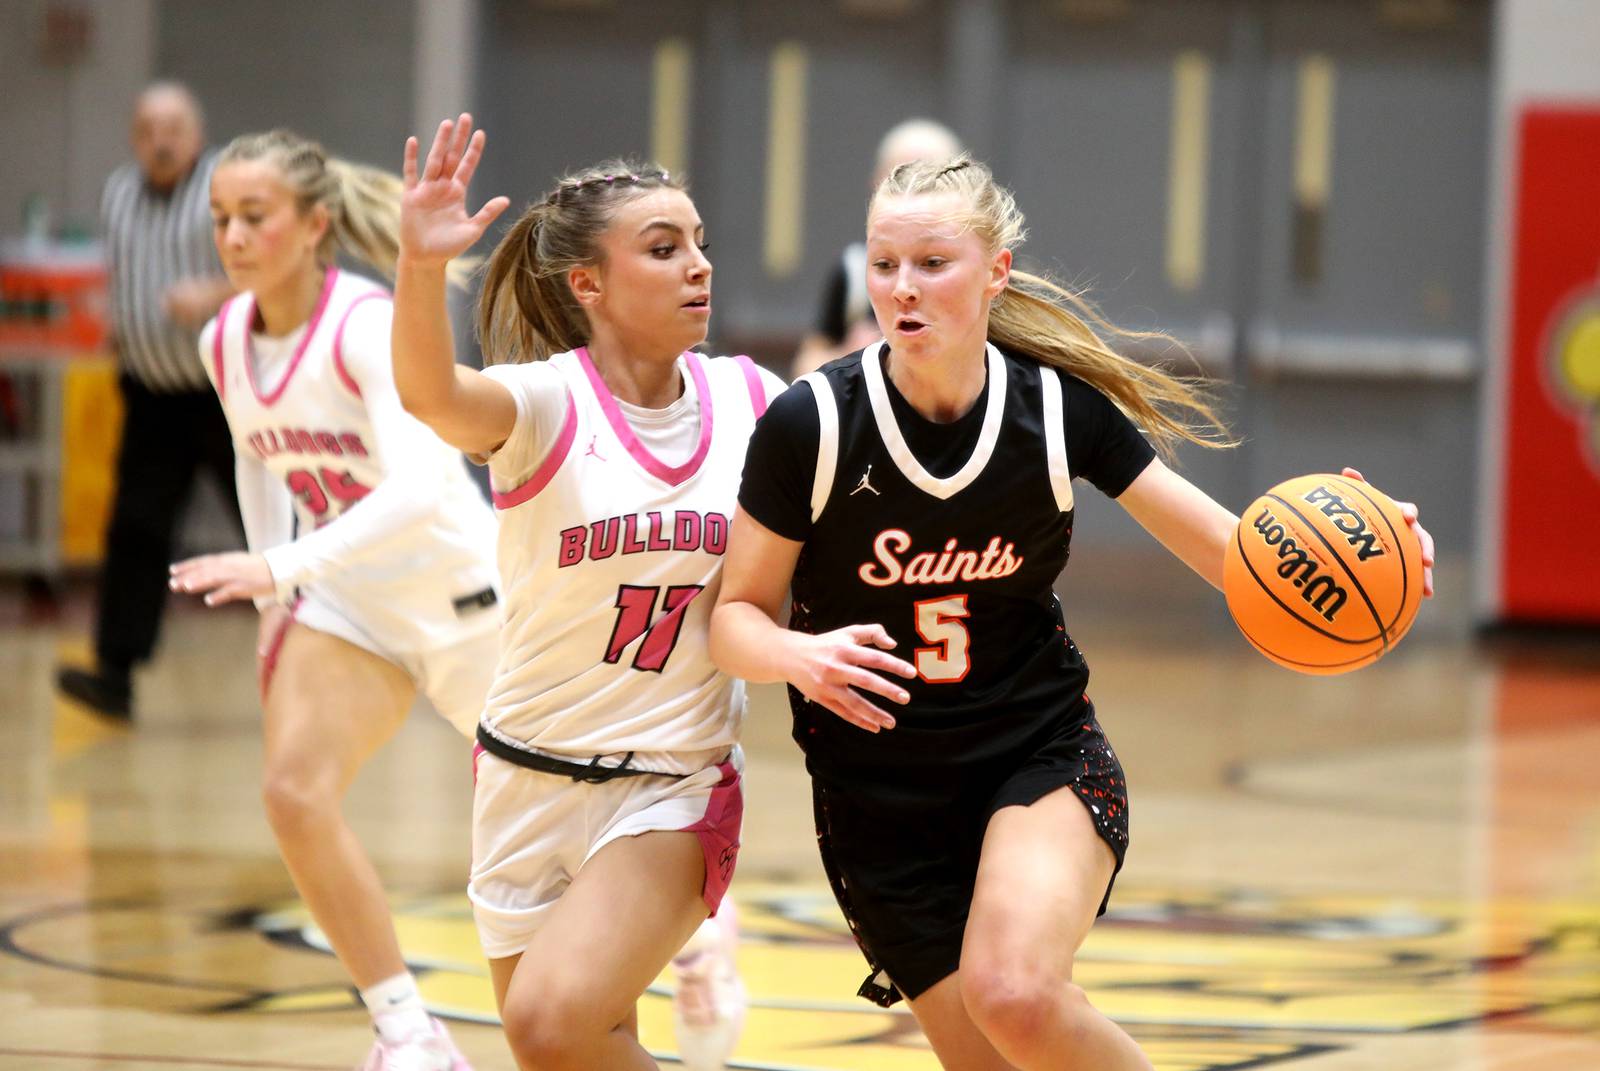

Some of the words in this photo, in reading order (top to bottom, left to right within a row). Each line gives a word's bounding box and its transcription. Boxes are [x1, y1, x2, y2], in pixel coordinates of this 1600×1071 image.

[557, 510, 733, 568] BULLDO
[858, 528, 1024, 587] Saints
[1253, 507, 1348, 623] Wilson
[1304, 486, 1385, 562] NCAA
[603, 584, 705, 673] 11
[913, 594, 971, 684] 5
